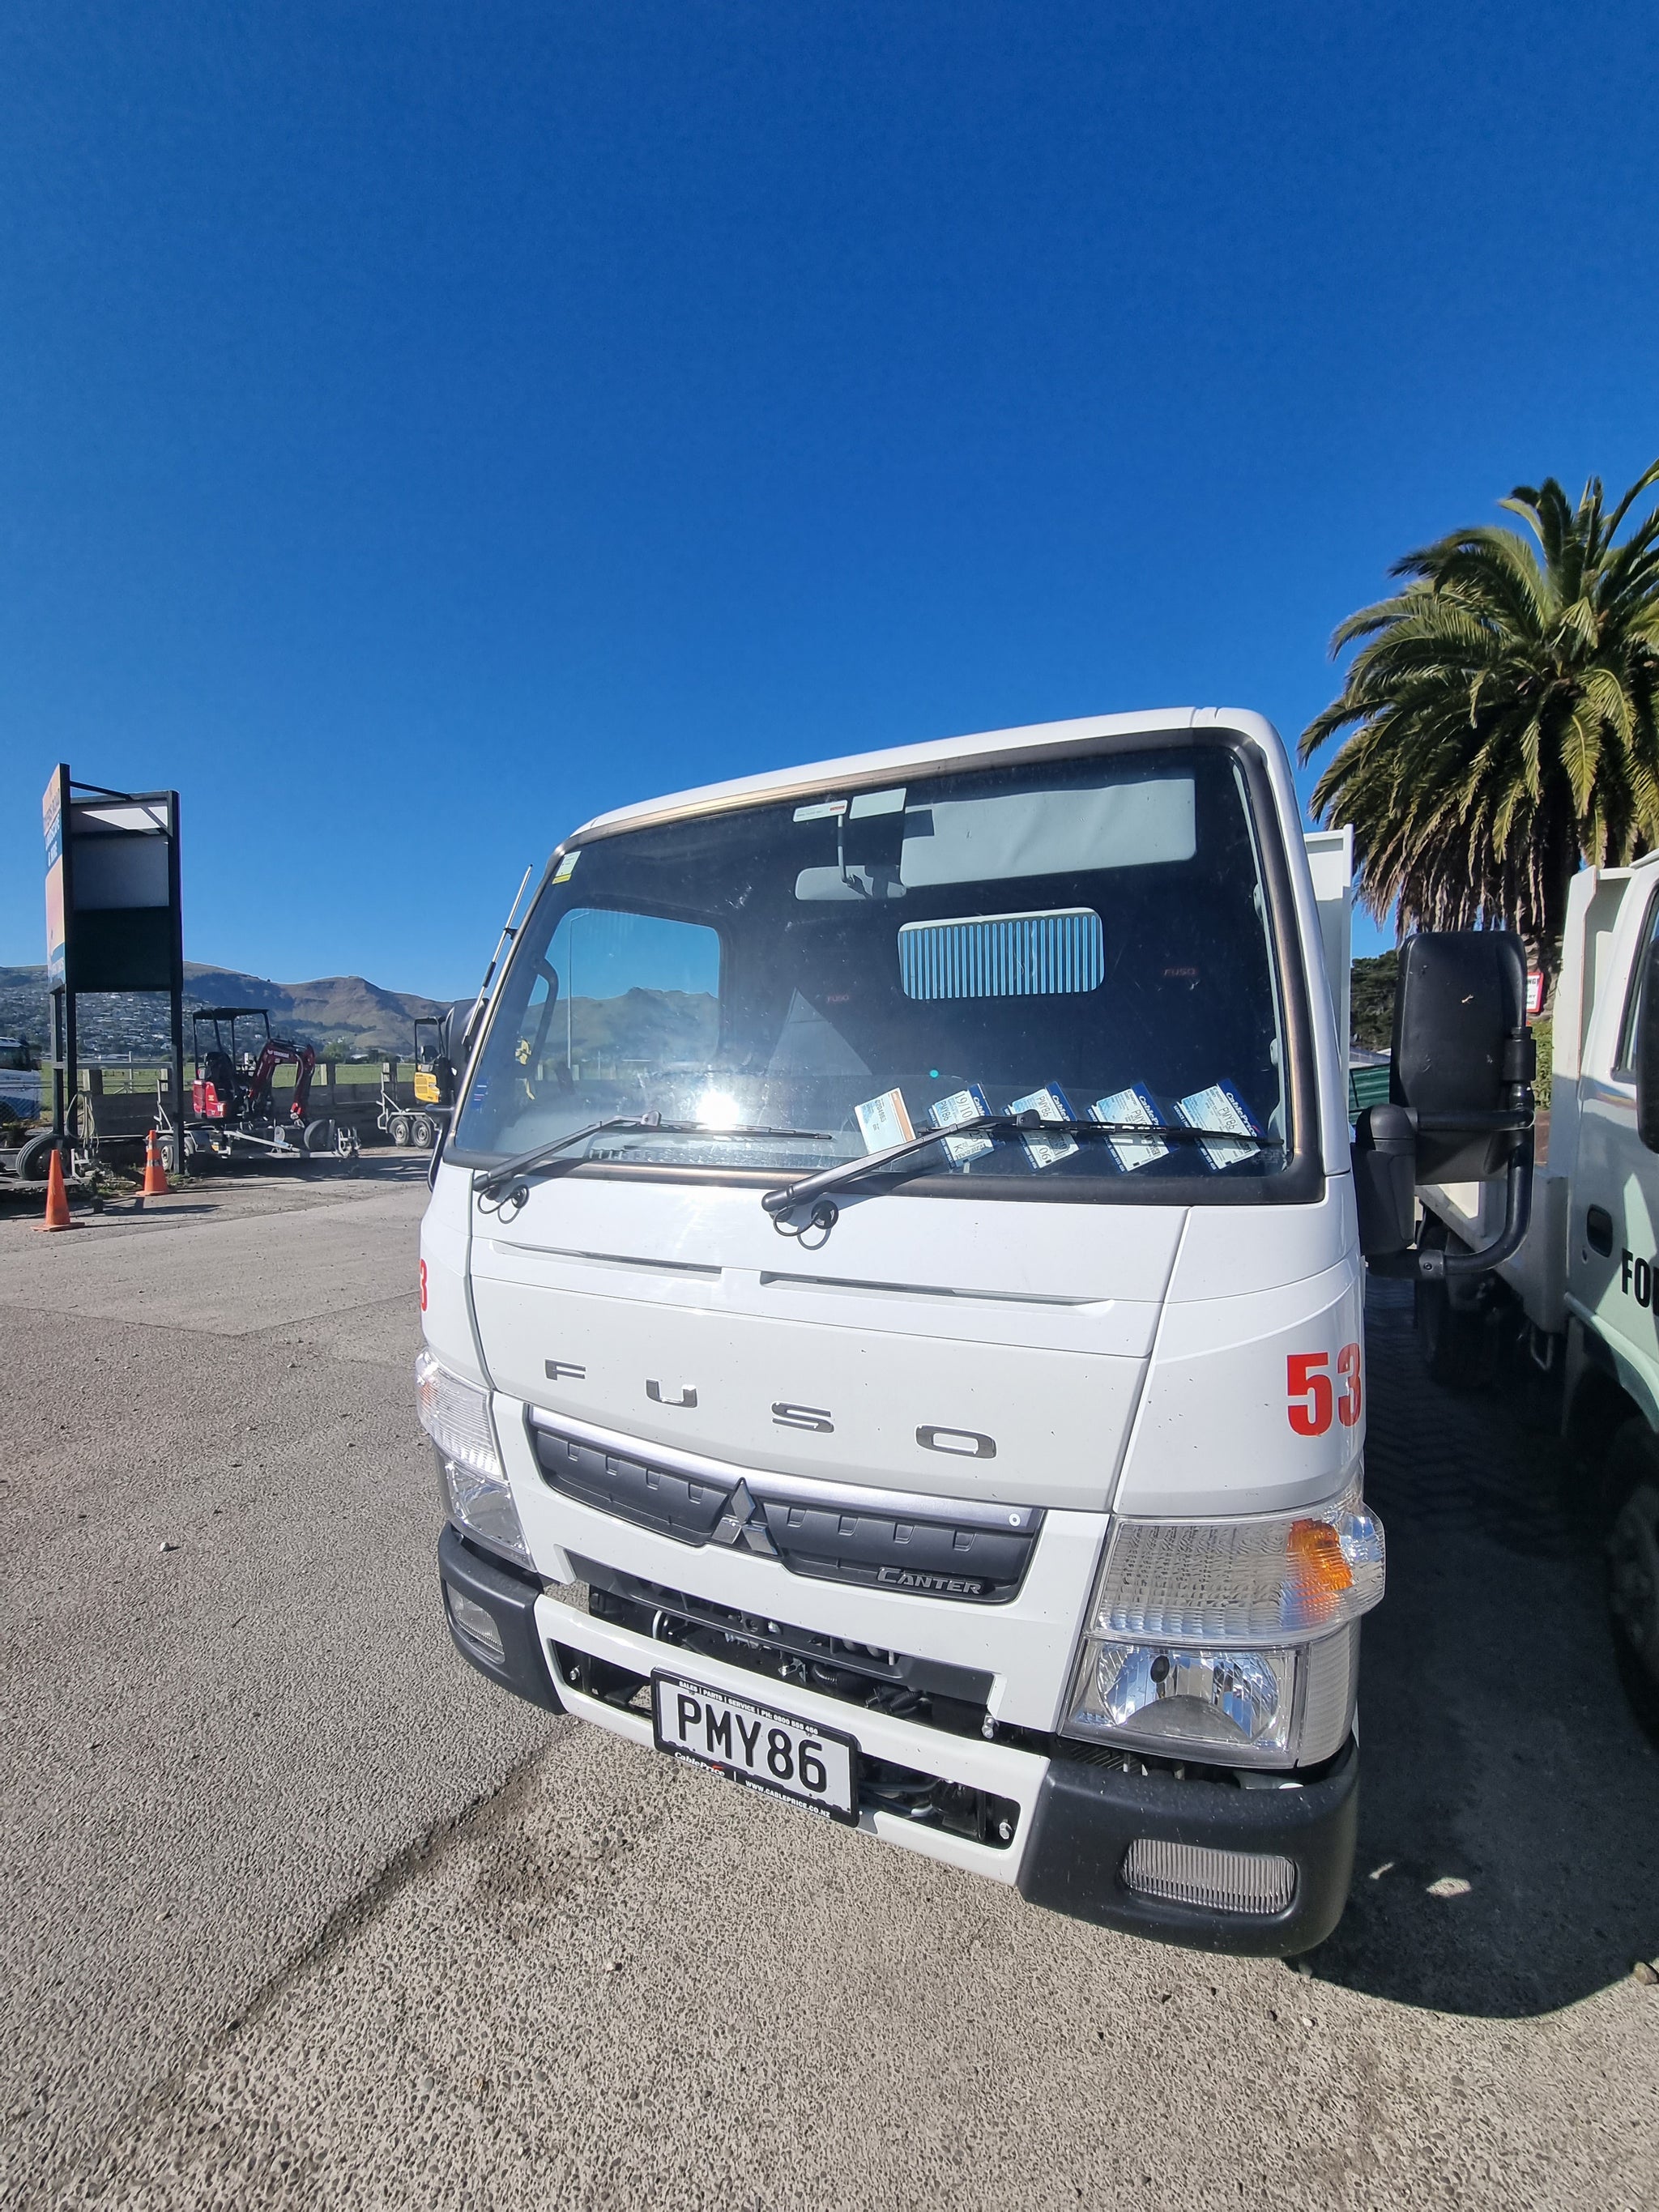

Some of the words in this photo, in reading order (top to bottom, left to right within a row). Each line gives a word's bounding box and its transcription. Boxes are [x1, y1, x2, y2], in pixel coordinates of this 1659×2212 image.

[1053, 1095, 1070, 1122] CableP
[545, 1358, 997, 1459] FUSO
[1286, 1343, 1362, 1437] 53
[877, 1566, 982, 1595] CANTER
[702, 1690, 723, 1702] PARTS
[727, 1698, 757, 1713] SERVICE
[677, 1693, 827, 1793] PMY86
[674, 1751, 725, 1777] CablePrice
[745, 1779, 831, 1819] WWW.CABLEPRICE.CO.NZ
